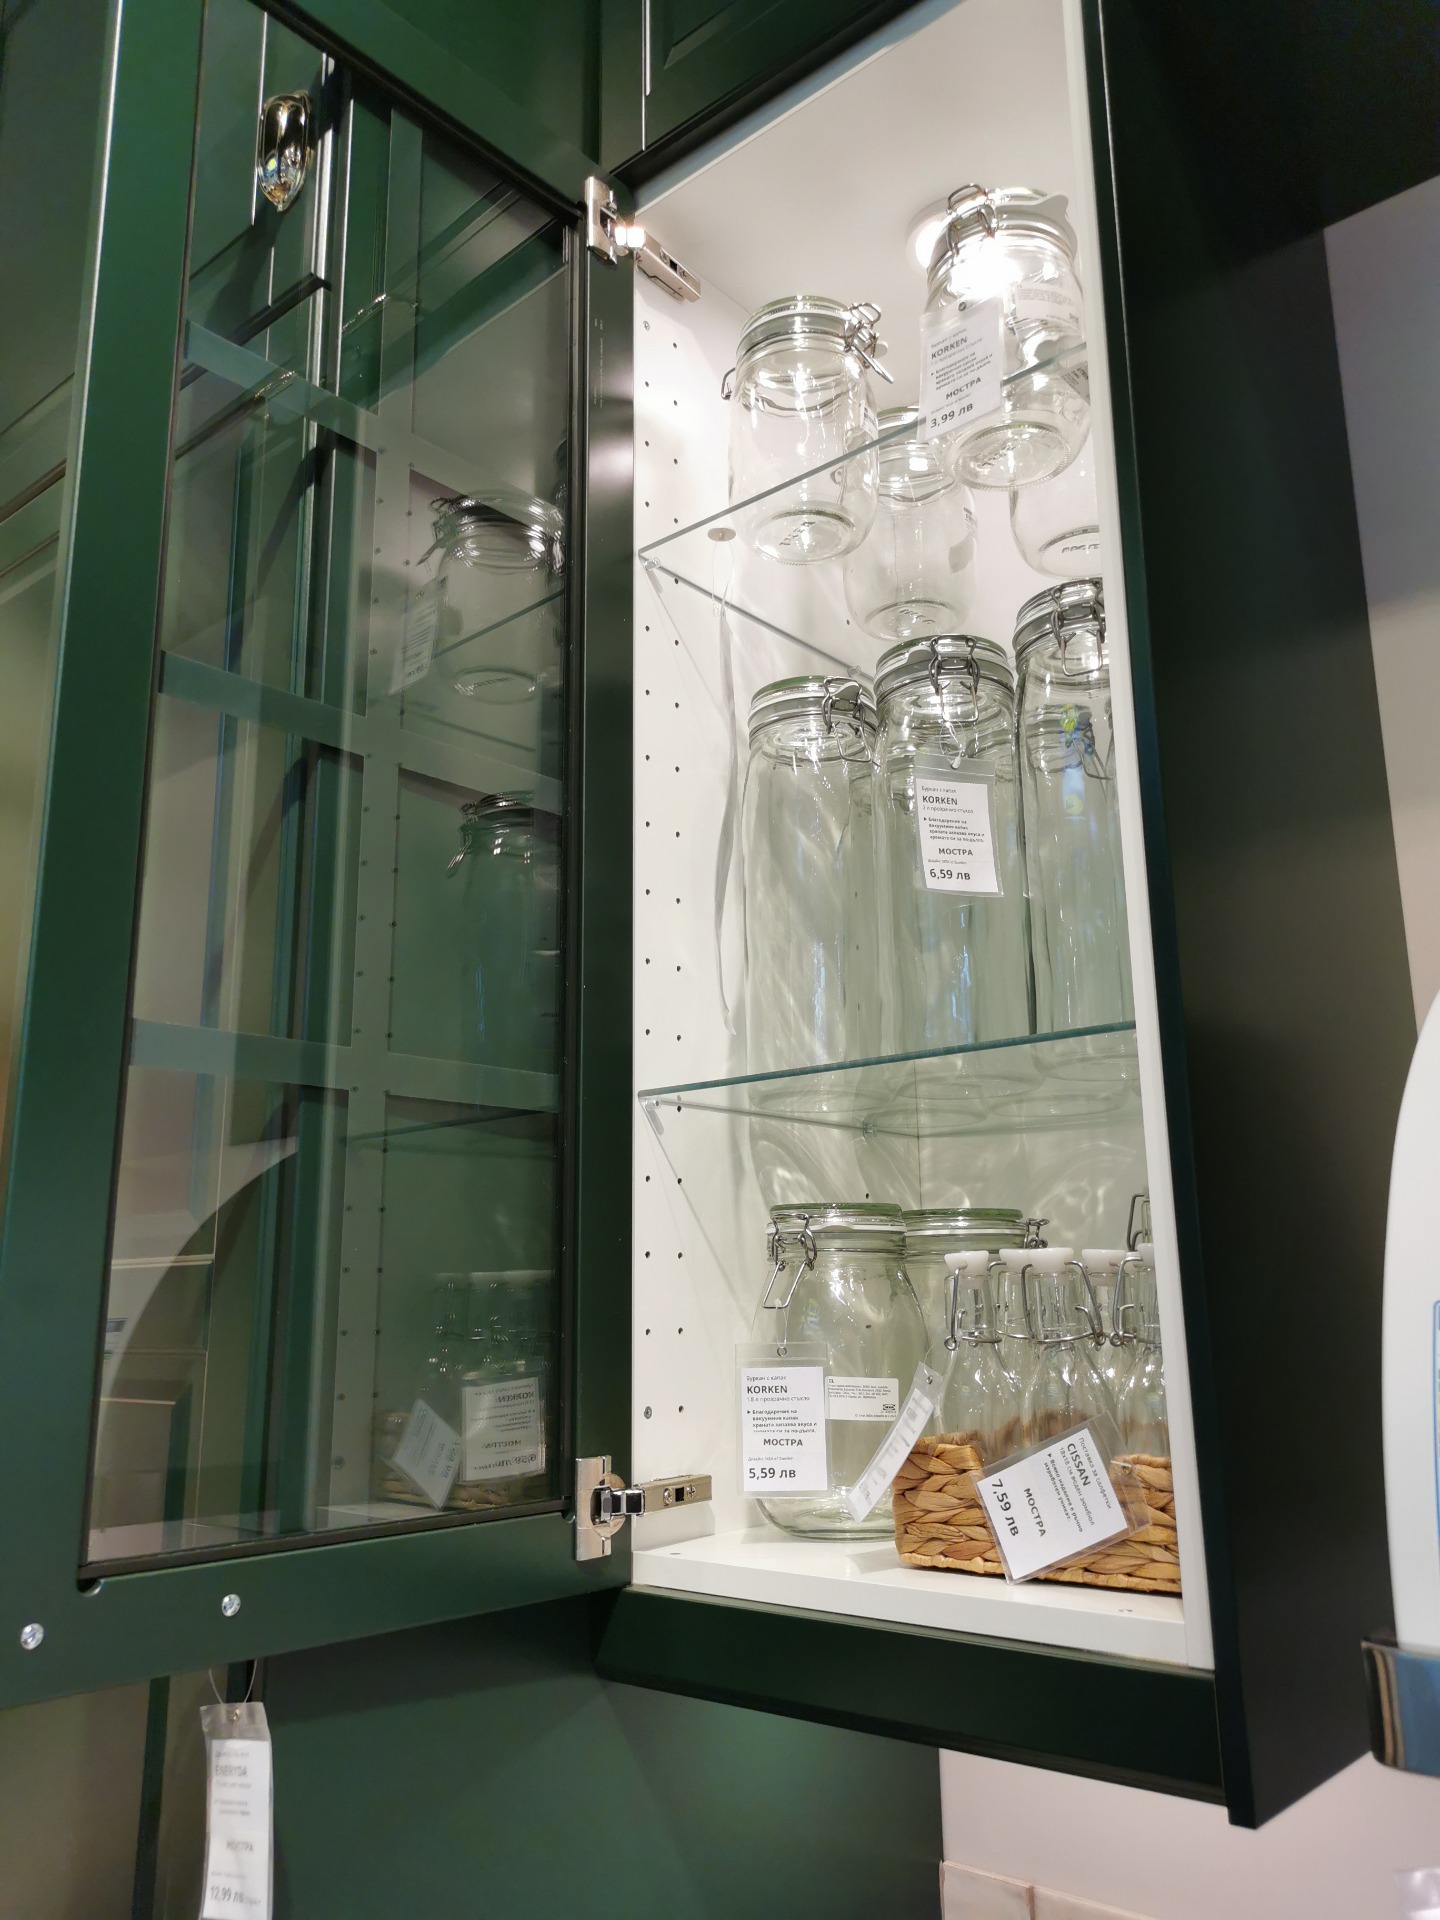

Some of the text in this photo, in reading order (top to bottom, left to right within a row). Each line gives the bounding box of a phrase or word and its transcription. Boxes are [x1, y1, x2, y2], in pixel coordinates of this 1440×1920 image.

[931, 336, 967, 360] KORKEN
[945, 377, 981, 400] МОСТРА
[931, 411, 955, 428] 3,99
[923, 796, 958, 805] KORKEN
[930, 869, 952, 880] 6,59
[747, 1385, 787, 1394] KORKEN
[749, 1468, 775, 1480] 5,59
[1067, 1443, 1090, 1486] CISSAN
[1079, 1437, 1111, 1510] Поставка за салфетки
[992, 1479, 1011, 1512] 7,59
[1070, 1475, 1083, 1497] воден
[1024, 1488, 1046, 1537] МОСТРА
